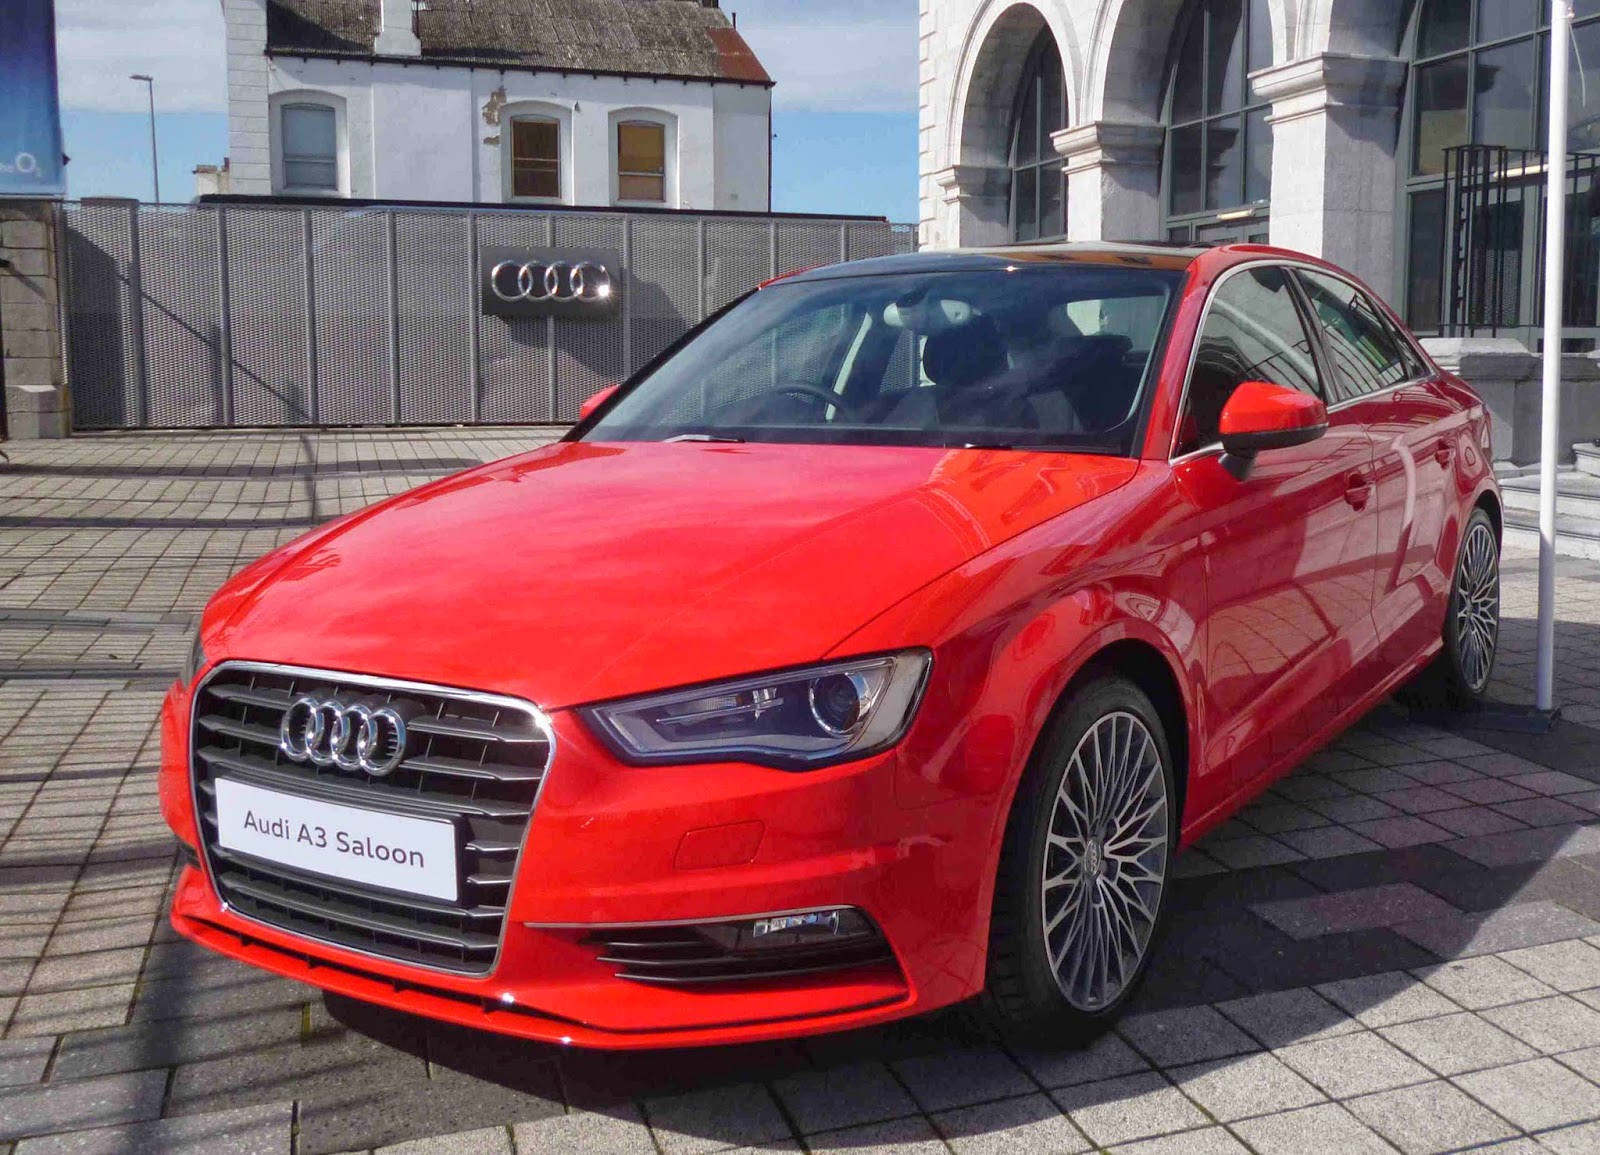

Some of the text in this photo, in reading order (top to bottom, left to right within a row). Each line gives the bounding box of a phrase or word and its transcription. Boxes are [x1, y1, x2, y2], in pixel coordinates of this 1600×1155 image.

[244, 810, 424, 868] Audi A3 Saloon
